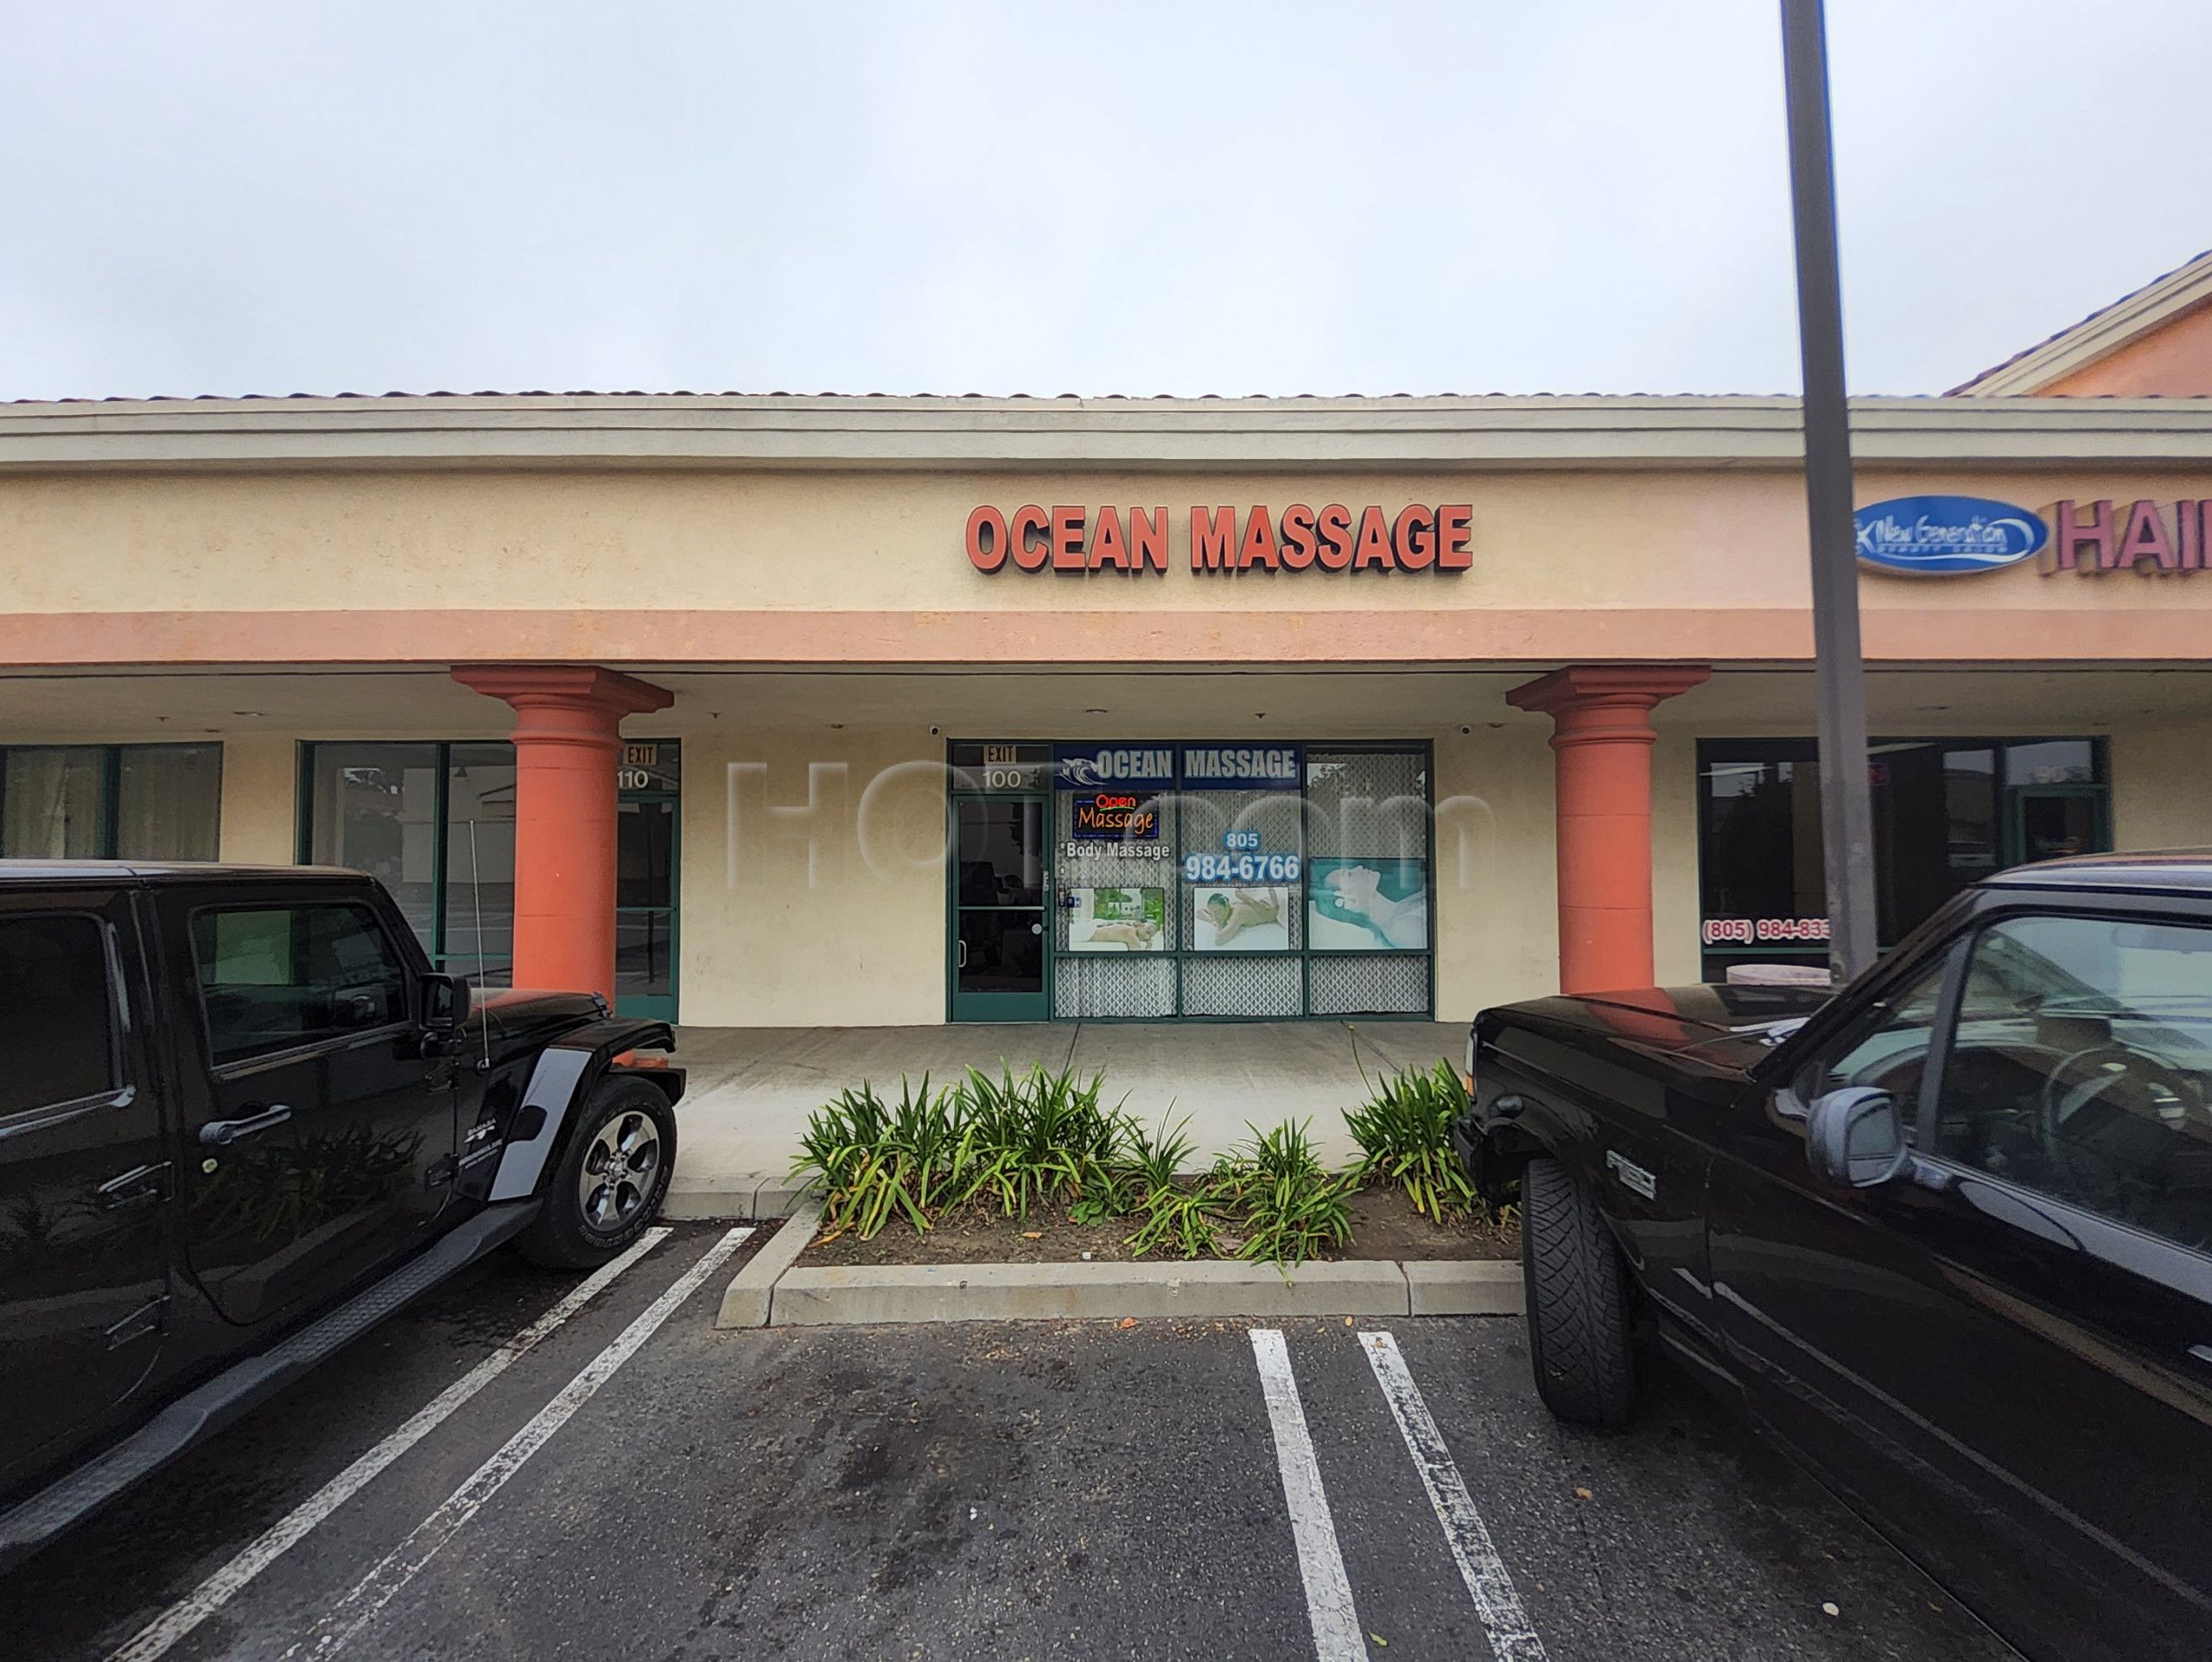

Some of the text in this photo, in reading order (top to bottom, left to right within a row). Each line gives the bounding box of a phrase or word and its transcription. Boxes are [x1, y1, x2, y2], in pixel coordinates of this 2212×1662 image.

[965, 504, 1473, 572] OCEAN MASSAGE
[627, 746, 654, 764] EXIT
[988, 746, 1014, 762] EXIT
[1096, 749, 1296, 779] OCEAN MASSAGE
[617, 770, 649, 789] 110
[982, 770, 1021, 788] 100
[1096, 794, 1136, 811] Open
[1078, 806, 1154, 835] Massage
[1226, 832, 1258, 848] 805
[1107, 842, 1170, 861] Massage
[1185, 854, 1299, 881] 984-6766
[1703, 920, 1754, 945] (805)
